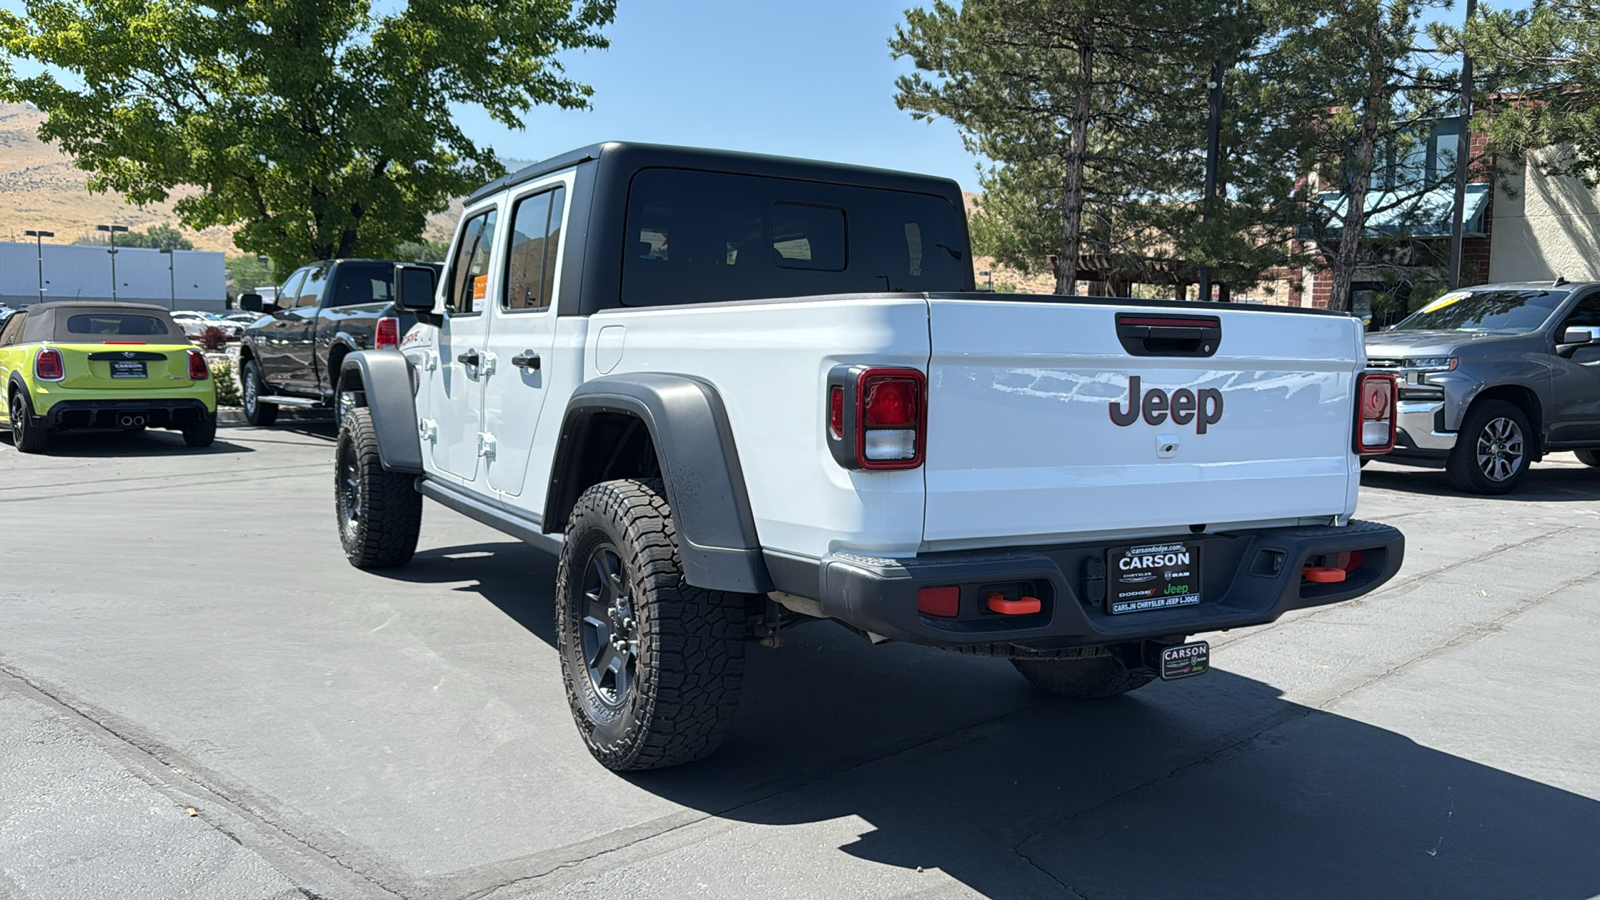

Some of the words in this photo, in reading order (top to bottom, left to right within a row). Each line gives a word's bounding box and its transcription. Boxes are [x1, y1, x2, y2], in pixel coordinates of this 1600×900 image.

[1108, 375, 1224, 435] Jeep
[1131, 545, 1181, 555] carsondodge.com
[1118, 552, 1190, 571] CARSON
[1118, 590, 1151, 598] DODGE
[1163, 583, 1189, 595] Jeep
[1136, 599, 1165, 609] CHRYSLER
[1165, 597, 1179, 605] JEEP
[1164, 646, 1207, 661] CARSON
